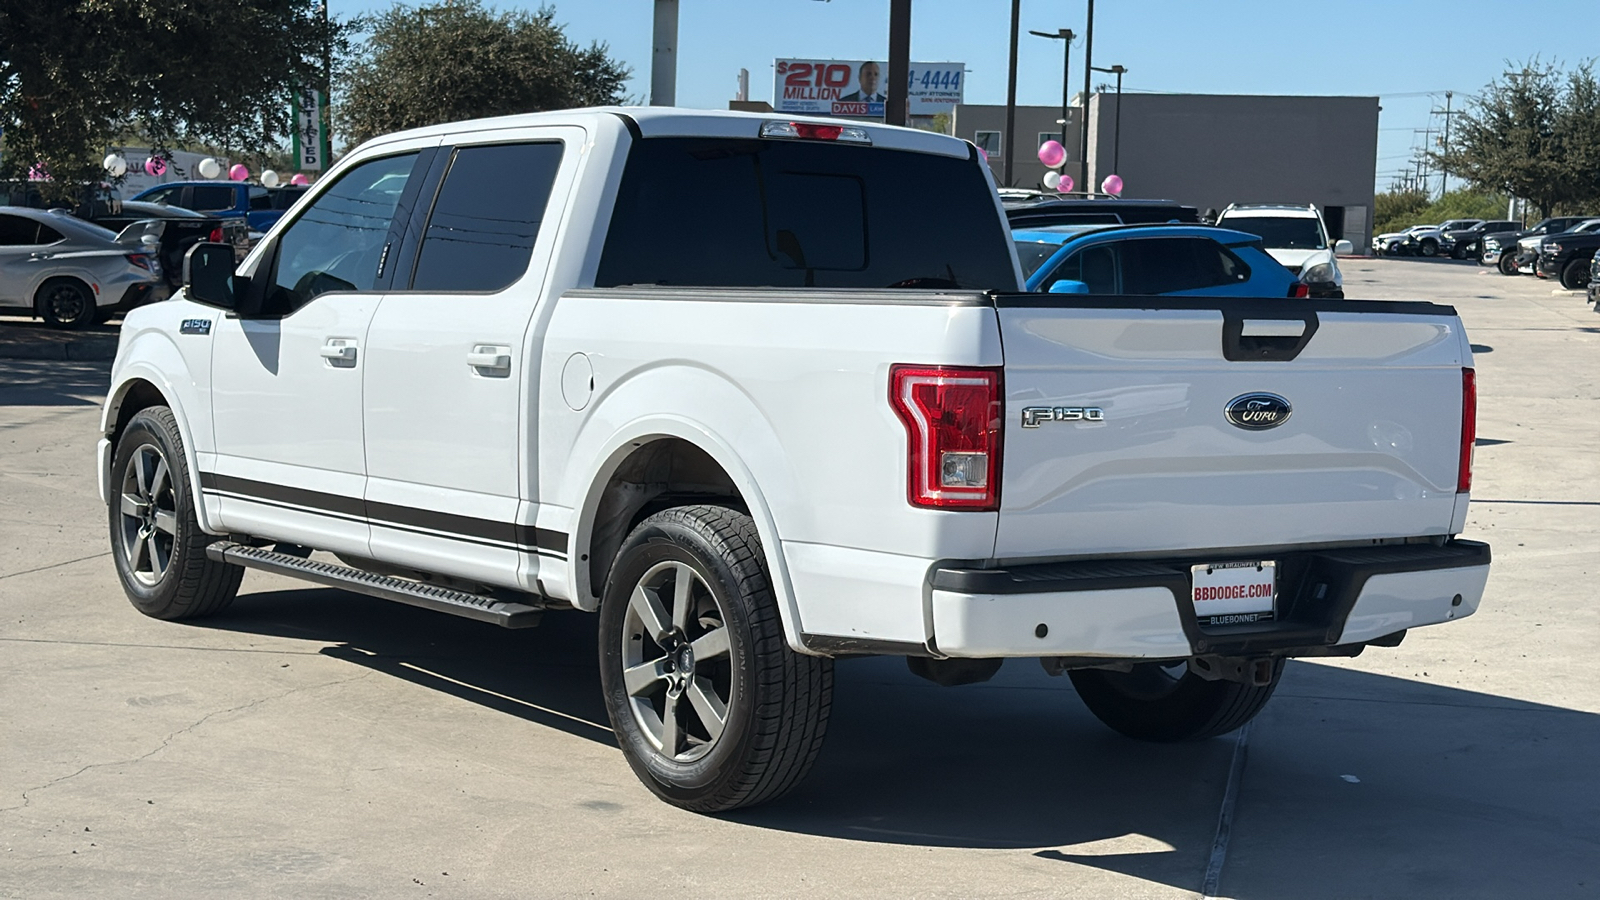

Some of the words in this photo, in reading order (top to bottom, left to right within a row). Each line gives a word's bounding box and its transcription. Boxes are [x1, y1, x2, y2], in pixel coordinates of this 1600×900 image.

[777, 62, 851, 88] $210
[783, 87, 842, 101] MILLION
[833, 104, 867, 114] DAVIS
[1022, 406, 1105, 428] F150
[1242, 400, 1280, 421] Ford
[1194, 583, 1272, 601] BBDODGE.COM
[1210, 614, 1259, 625] BLUEBONNET
